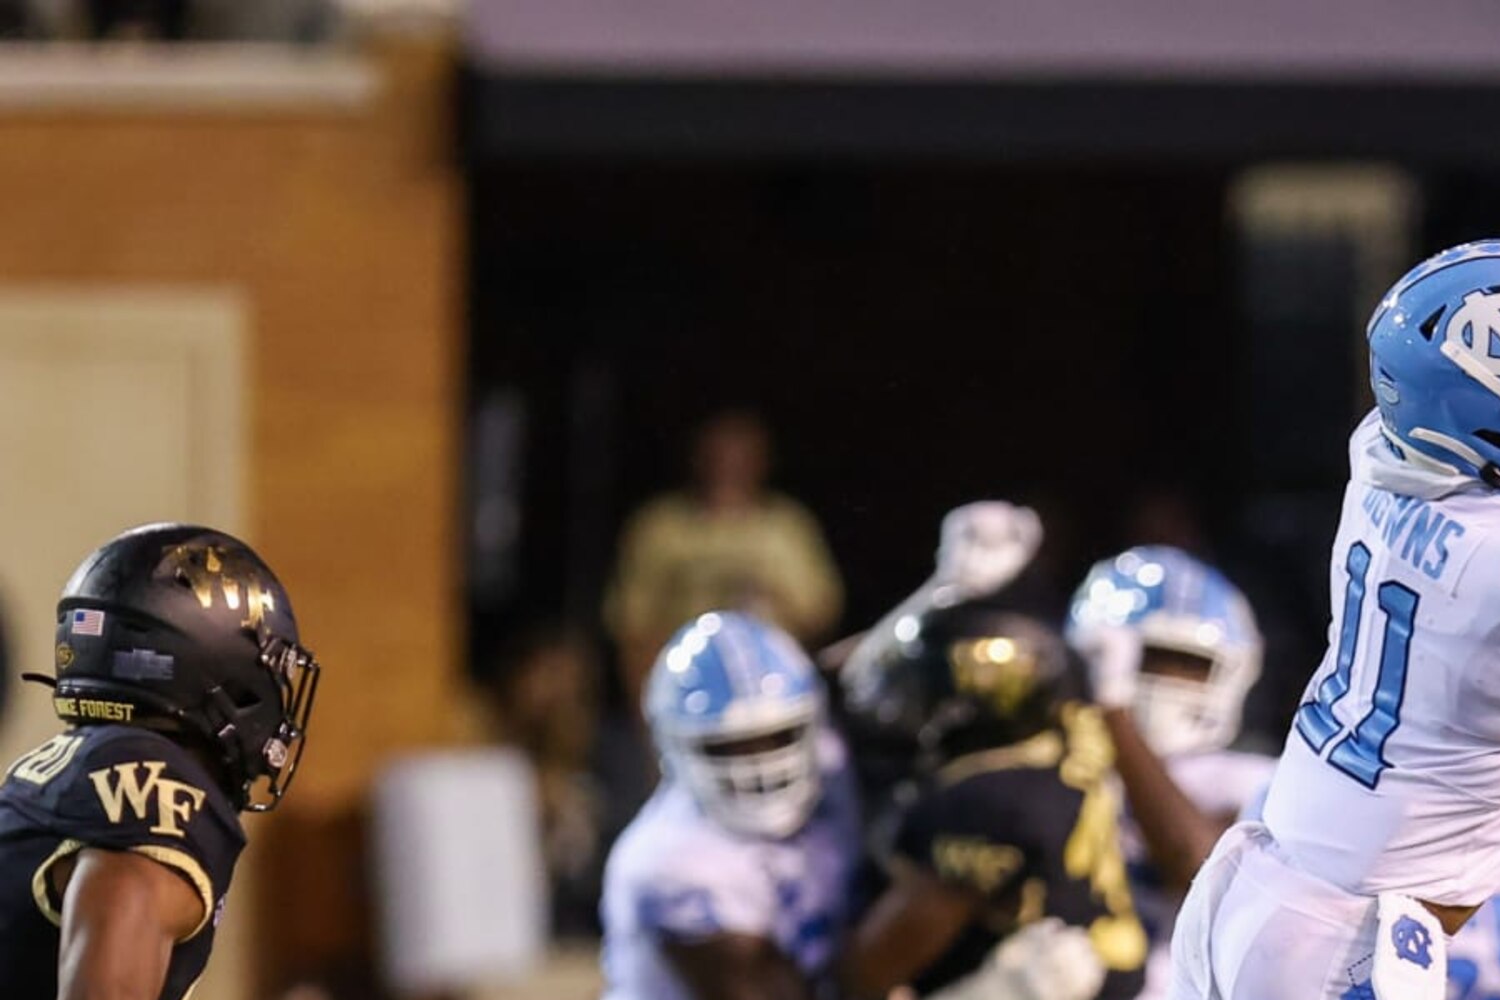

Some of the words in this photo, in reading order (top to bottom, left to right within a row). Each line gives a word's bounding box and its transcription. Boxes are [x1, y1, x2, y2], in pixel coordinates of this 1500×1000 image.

[1295, 541, 1420, 790] 11
[79, 700, 134, 720] FOREST
[89, 761, 205, 838] WF
